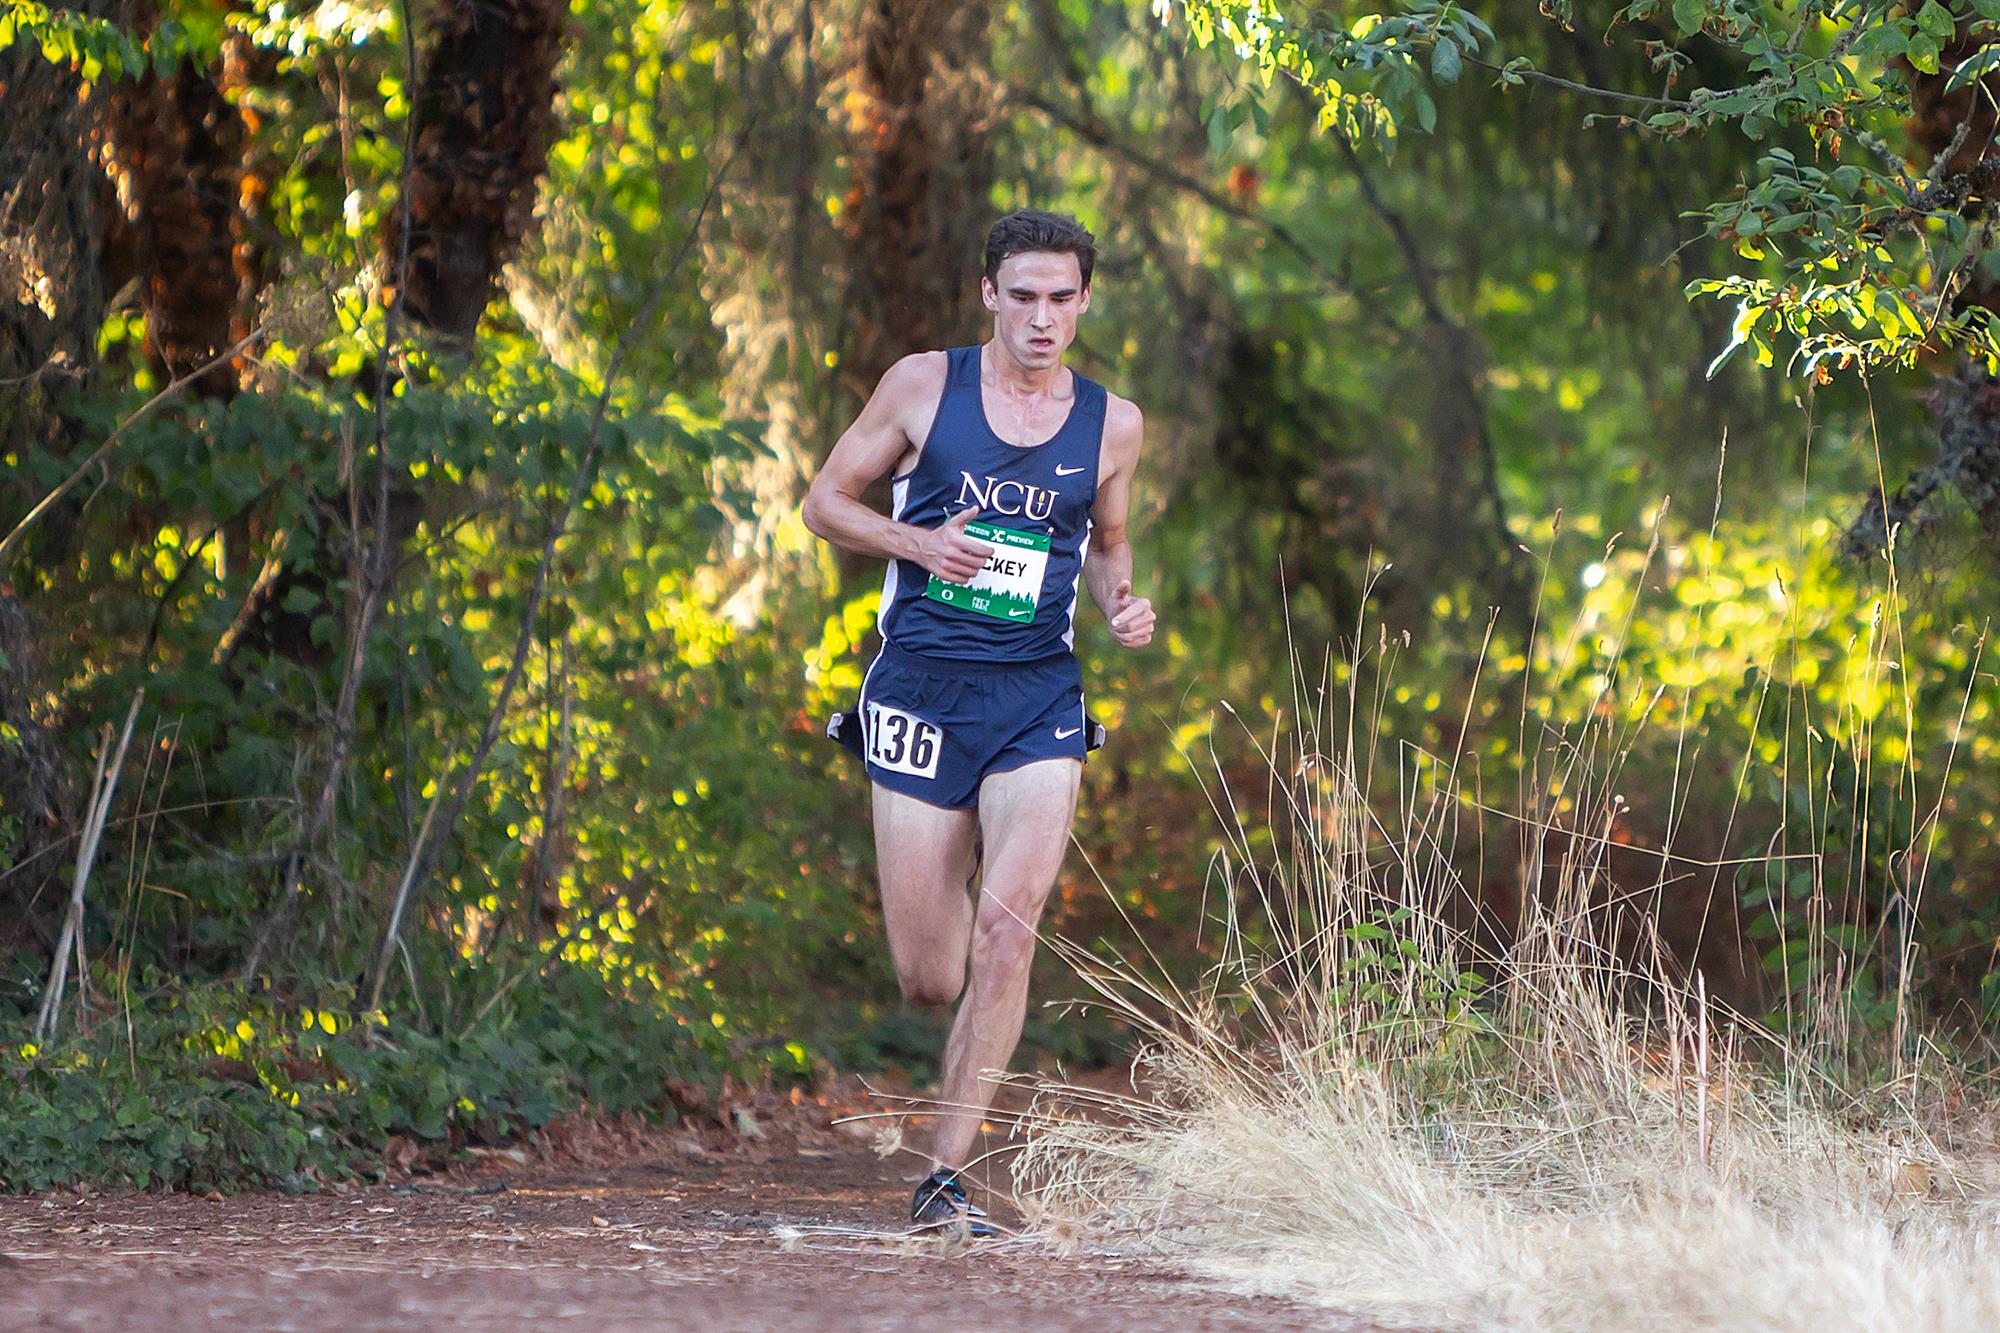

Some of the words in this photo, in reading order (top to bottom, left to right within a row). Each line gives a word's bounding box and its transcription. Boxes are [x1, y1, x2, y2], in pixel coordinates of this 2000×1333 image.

[954, 470, 1060, 521] NCU
[990, 528, 1006, 543] XC
[1006, 534, 1035, 546] PREVIEW
[872, 710, 936, 769] 136
